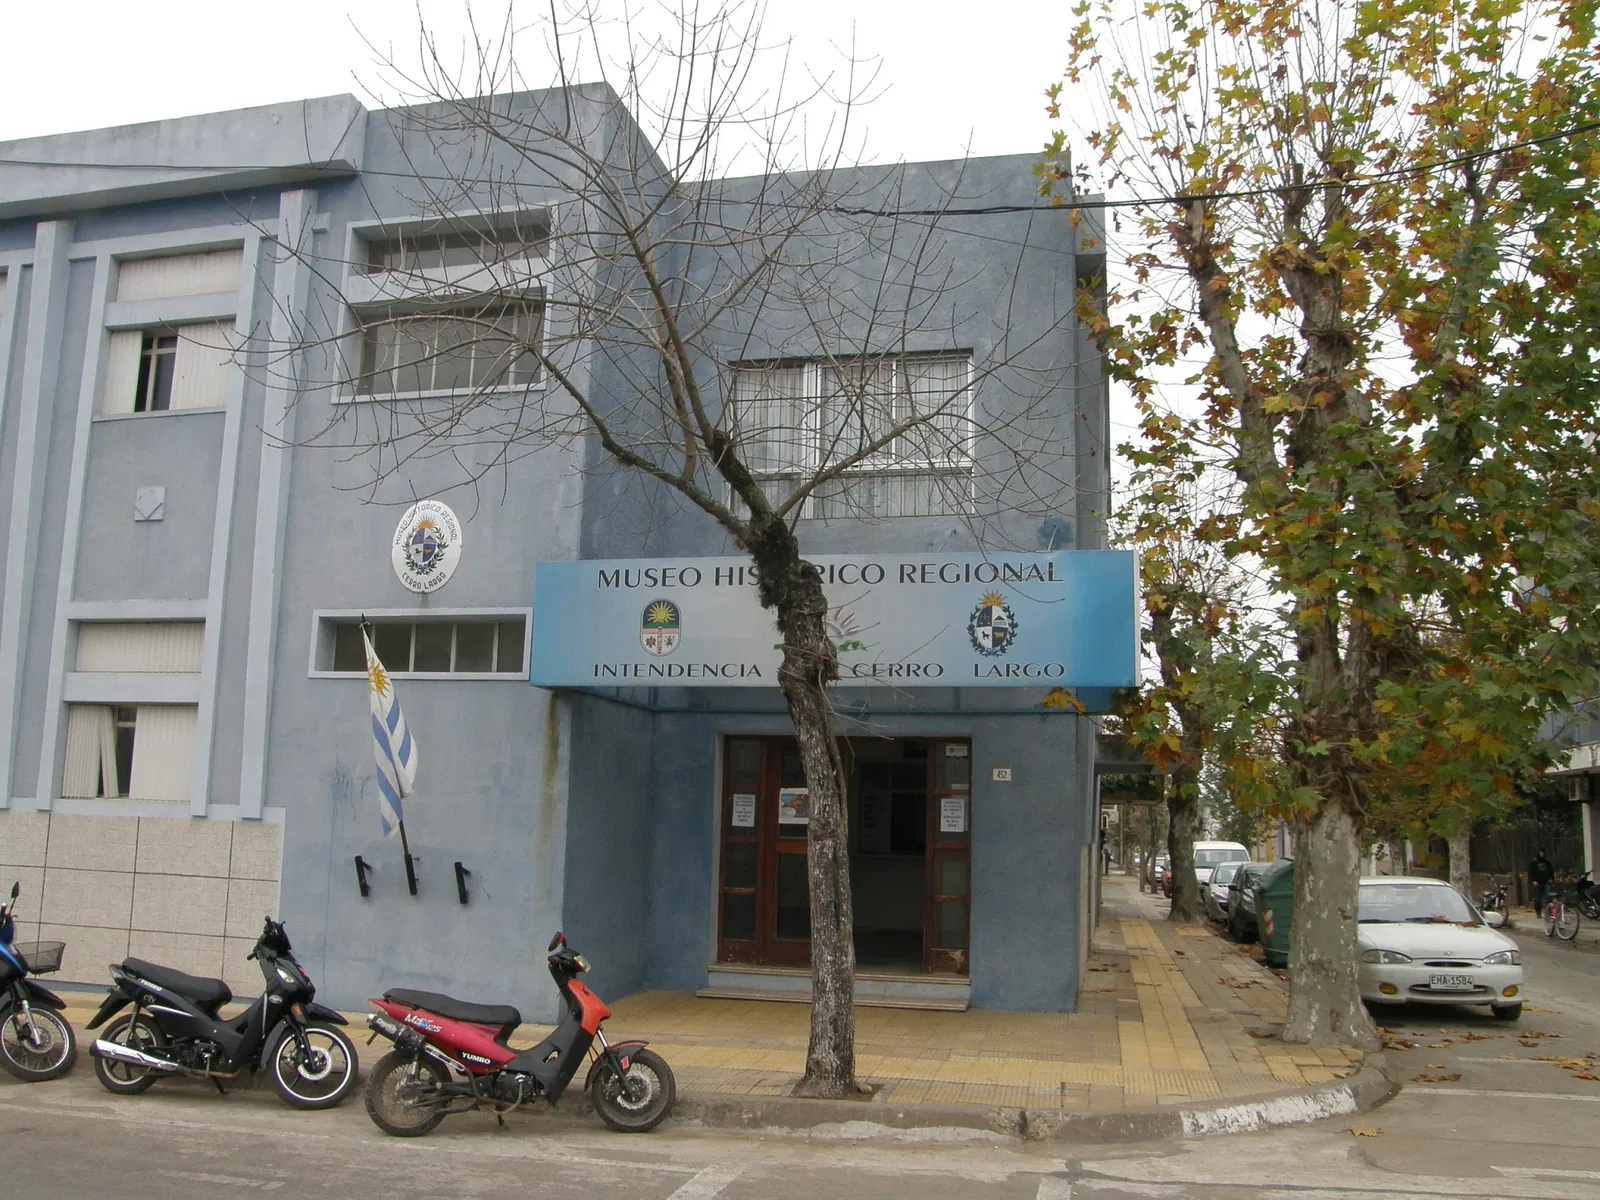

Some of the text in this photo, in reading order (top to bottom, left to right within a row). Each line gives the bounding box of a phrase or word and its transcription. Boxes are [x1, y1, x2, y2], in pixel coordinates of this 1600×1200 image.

[395, 520, 409, 546] MUSEO
[441, 510, 458, 543] REGIONAL
[401, 571, 447, 590] CERRO LARGO
[598, 561, 1065, 589] MUSEO HISRICO REGIONAL
[593, 662, 1066, 678] INTENDENCIA CERRO LARGO
[996, 770, 1008, 779] 452
[462, 1052, 491, 1065] YUMBO
